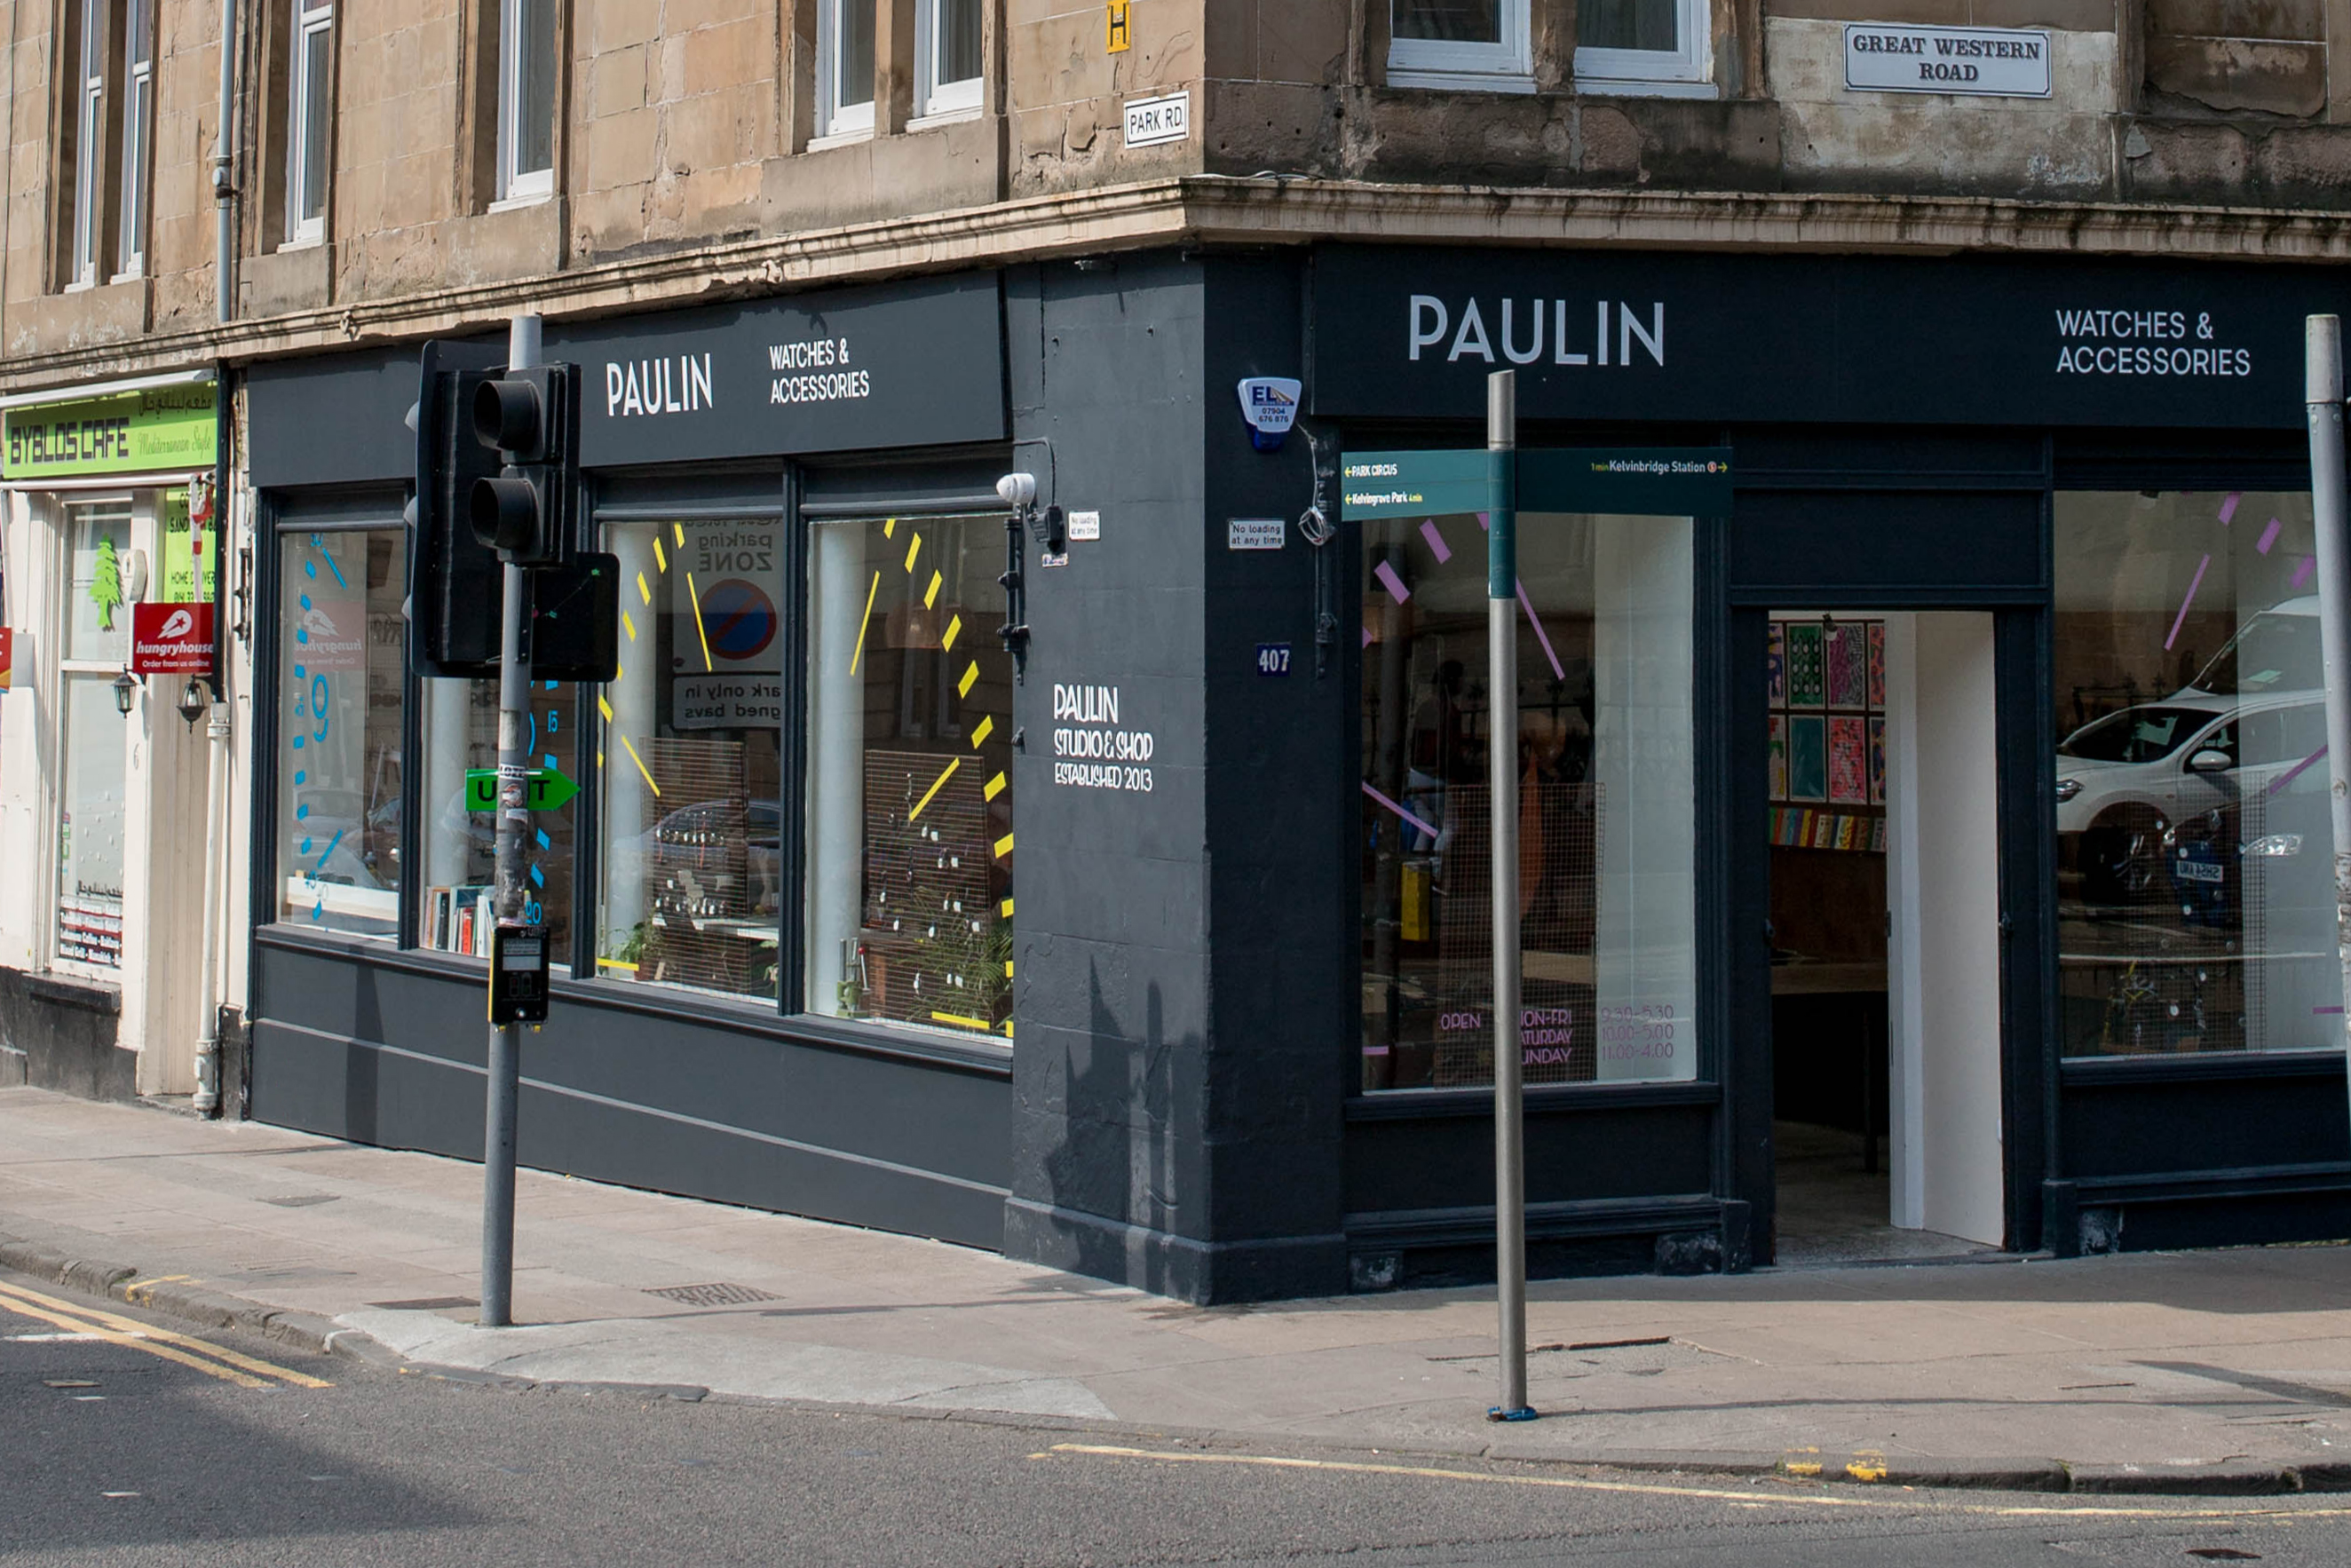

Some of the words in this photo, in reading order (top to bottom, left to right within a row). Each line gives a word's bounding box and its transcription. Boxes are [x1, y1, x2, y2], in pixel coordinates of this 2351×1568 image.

[1853, 34, 1926, 55] GREAT
[1934, 38, 2040, 59] WESTERN
[1919, 62, 1979, 81] ROAD
[1130, 109, 1161, 135] PARK
[1409, 294, 1665, 367] PAULIN
[2056, 310, 2185, 339] WATCHES
[2196, 312, 2213, 339] &
[769, 339, 835, 370] WATCHES
[838, 337, 849, 364] &
[2056, 346, 2251, 376] ACCESSORIES
[606, 352, 713, 416] PAULIN
[770, 369, 870, 404] ACCESSORIES
[1252, 385, 1278, 400] EL
[11, 422, 78, 465] BYBLOS
[81, 416, 130, 459] CAFE
[1352, 465, 1371, 477] PARK
[1372, 463, 1397, 476] CIRCUS
[1610, 460, 1669, 475] Kelvinbridge
[1672, 461, 1706, 472] Station
[1391, 491, 1408, 503] Park
[1231, 535, 1240, 544] at
[1244, 536, 1259, 546] any
[1263, 535, 1282, 544] time
[1233, 524, 1246, 533] No
[1249, 524, 1280, 535] loading
[1258, 649, 1289, 672] 407
[1054, 684, 1119, 724] PAULIN
[1054, 728, 1103, 757] STUDIO
[1104, 730, 1115, 758] &
[1115, 731, 1153, 761] SHOP
[1055, 762, 1122, 788] ESTABLISHED
[1124, 766, 1153, 791] 2013
[1440, 1012, 1481, 1030] OPEN
[1520, 1010, 1572, 1027] ON-FRI
[1520, 1028, 1573, 1046] ATURDAY
[1521, 1047, 1572, 1065] UNDAY
